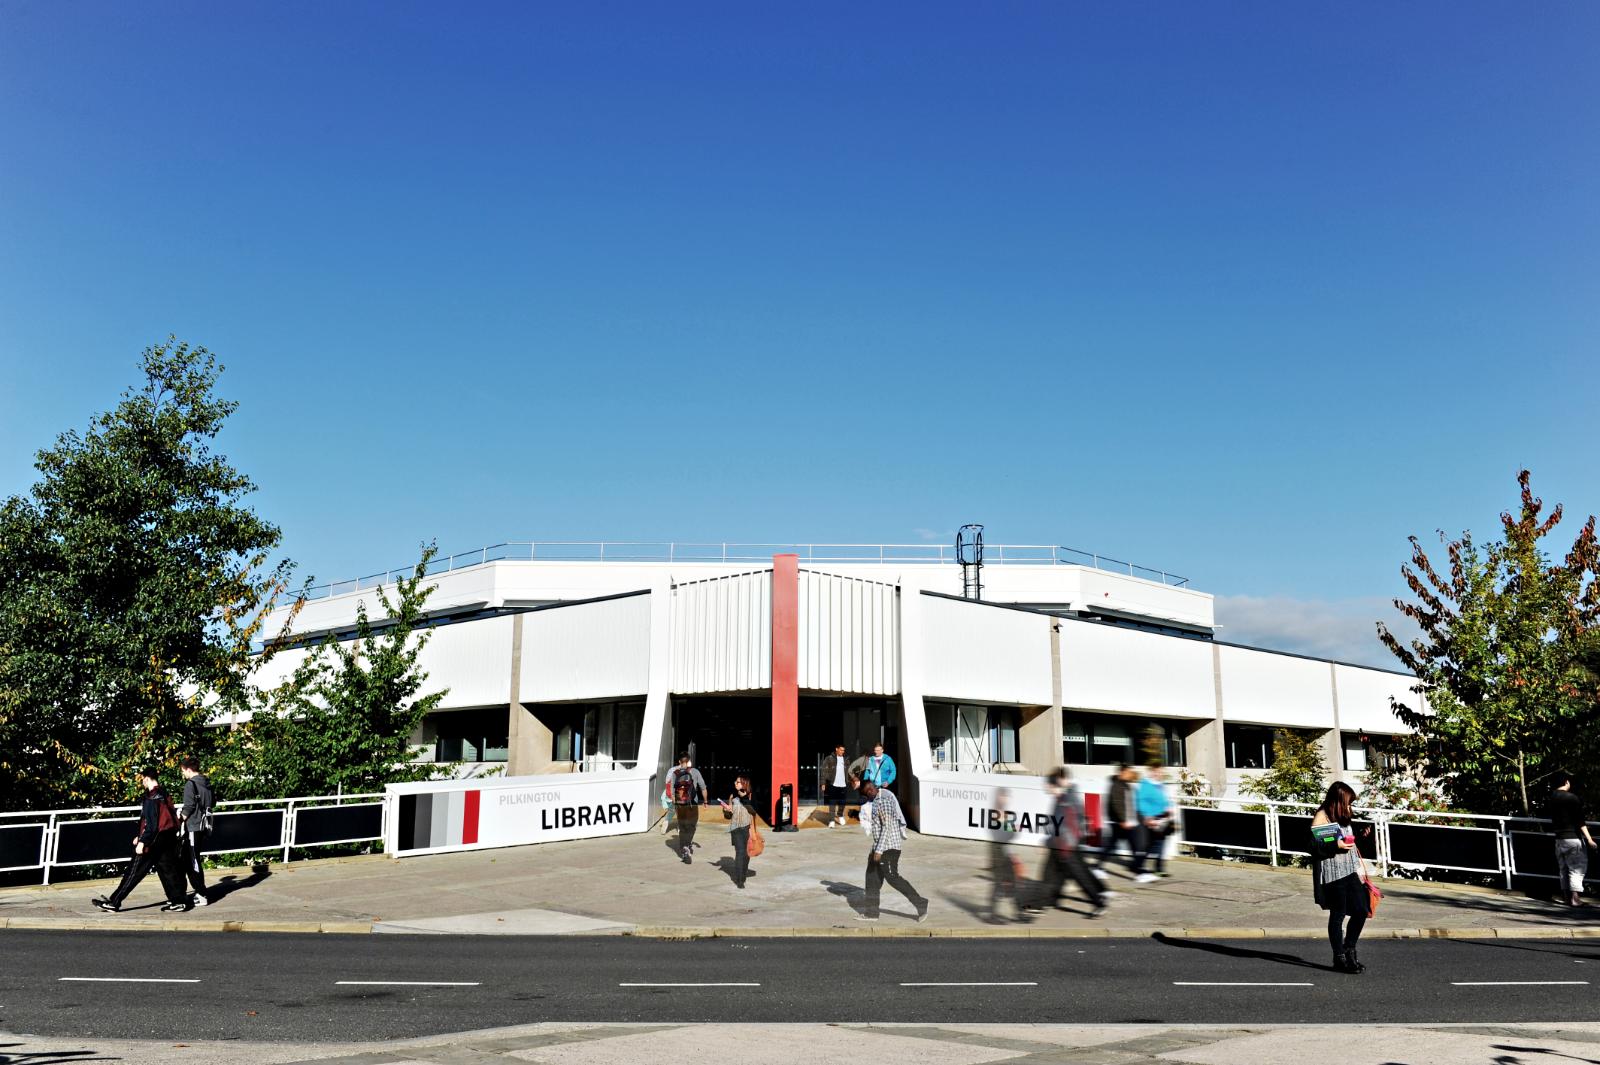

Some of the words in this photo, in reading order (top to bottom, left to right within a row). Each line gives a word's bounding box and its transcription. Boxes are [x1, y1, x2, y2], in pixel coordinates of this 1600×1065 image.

[499, 791, 561, 805] PILKINGTON
[932, 787, 987, 801] PILKINGTON
[541, 802, 634, 830] LIBRARY
[968, 807, 1064, 836] LIBRARY
